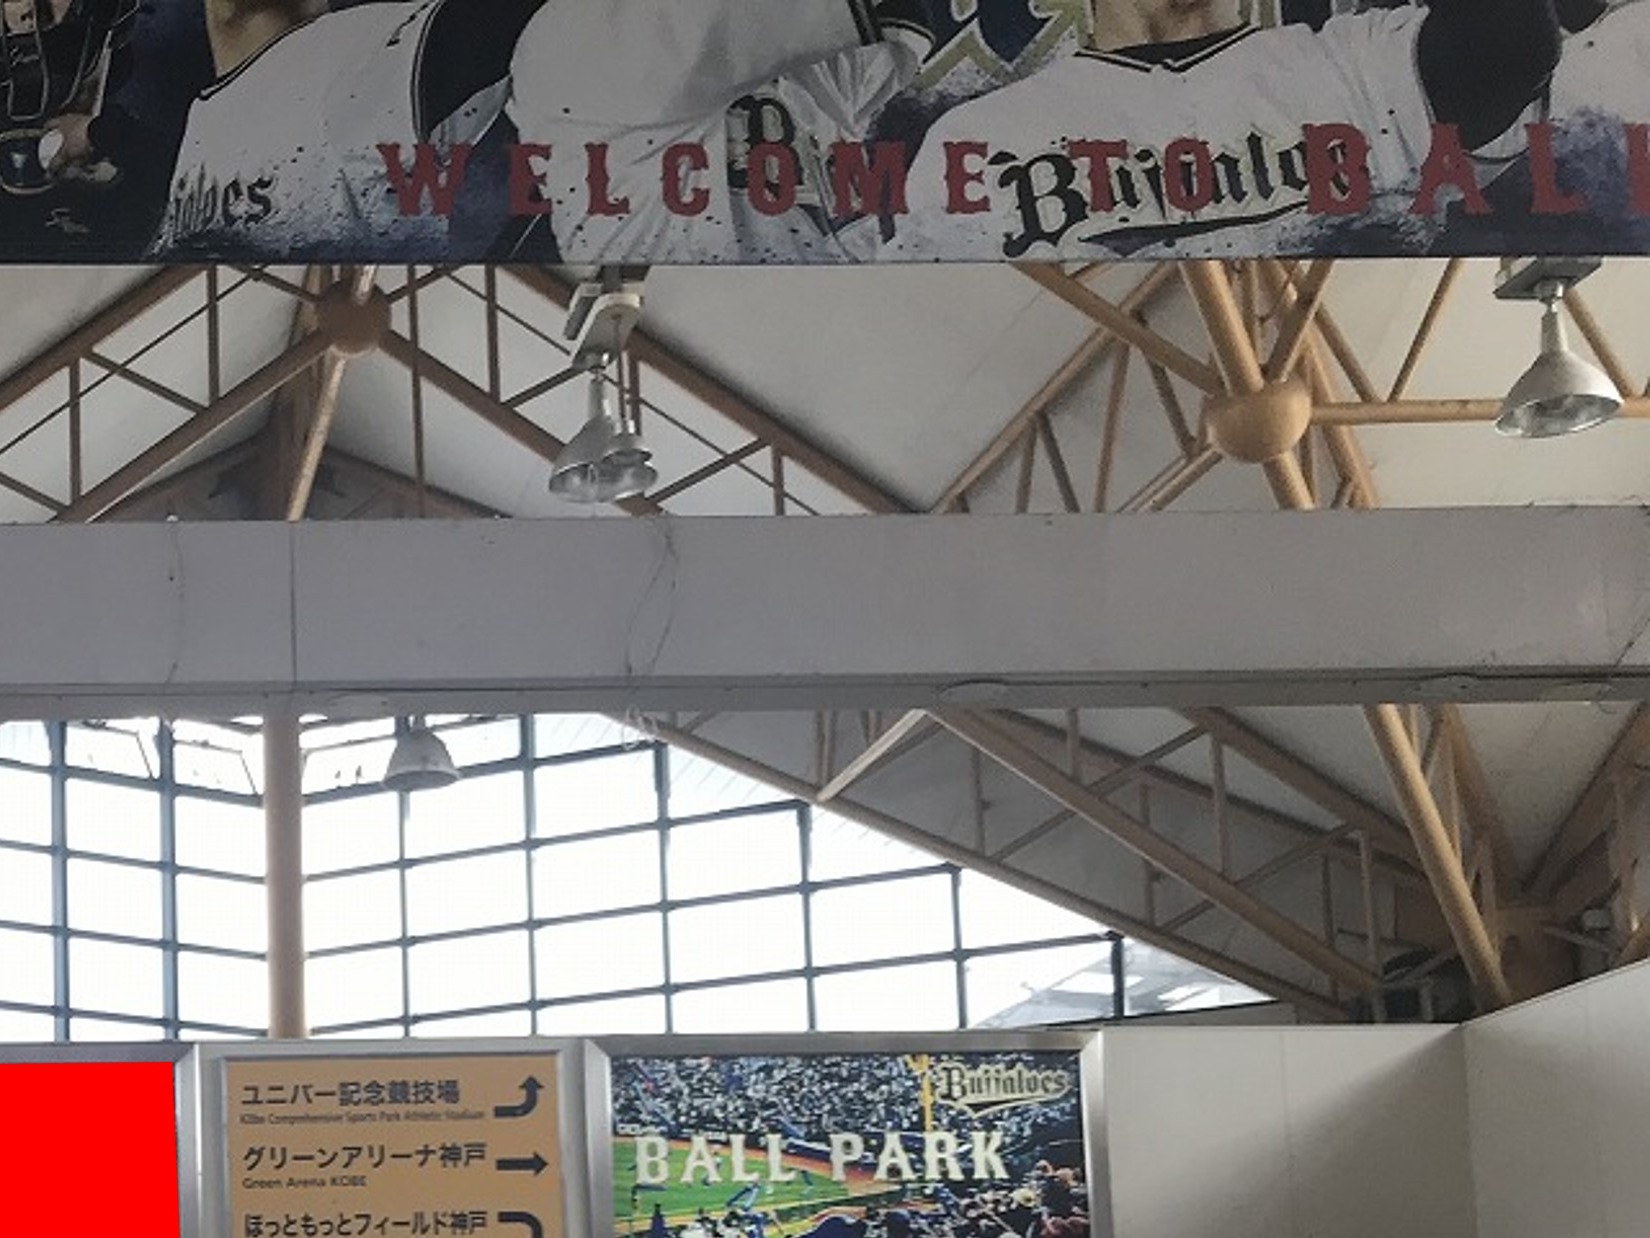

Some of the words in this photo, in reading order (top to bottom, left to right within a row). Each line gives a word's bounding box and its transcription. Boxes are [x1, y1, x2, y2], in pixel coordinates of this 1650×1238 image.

[377, 138, 991, 217] WELCOME
[1067, 137, 1214, 213] TO
[241, 1079, 460, 1107] ユニバー記念競技場
[243, 1142, 486, 1171] グリーンアリーナ神戸
[633, 1132, 797, 1185] BALL
[828, 1130, 1011, 1183] PARK
[242, 1177, 282, 1189] Green
[329, 1175, 367, 1187] KOBE
[244, 1211, 487, 1238] ほっともっとフィールド神戸
